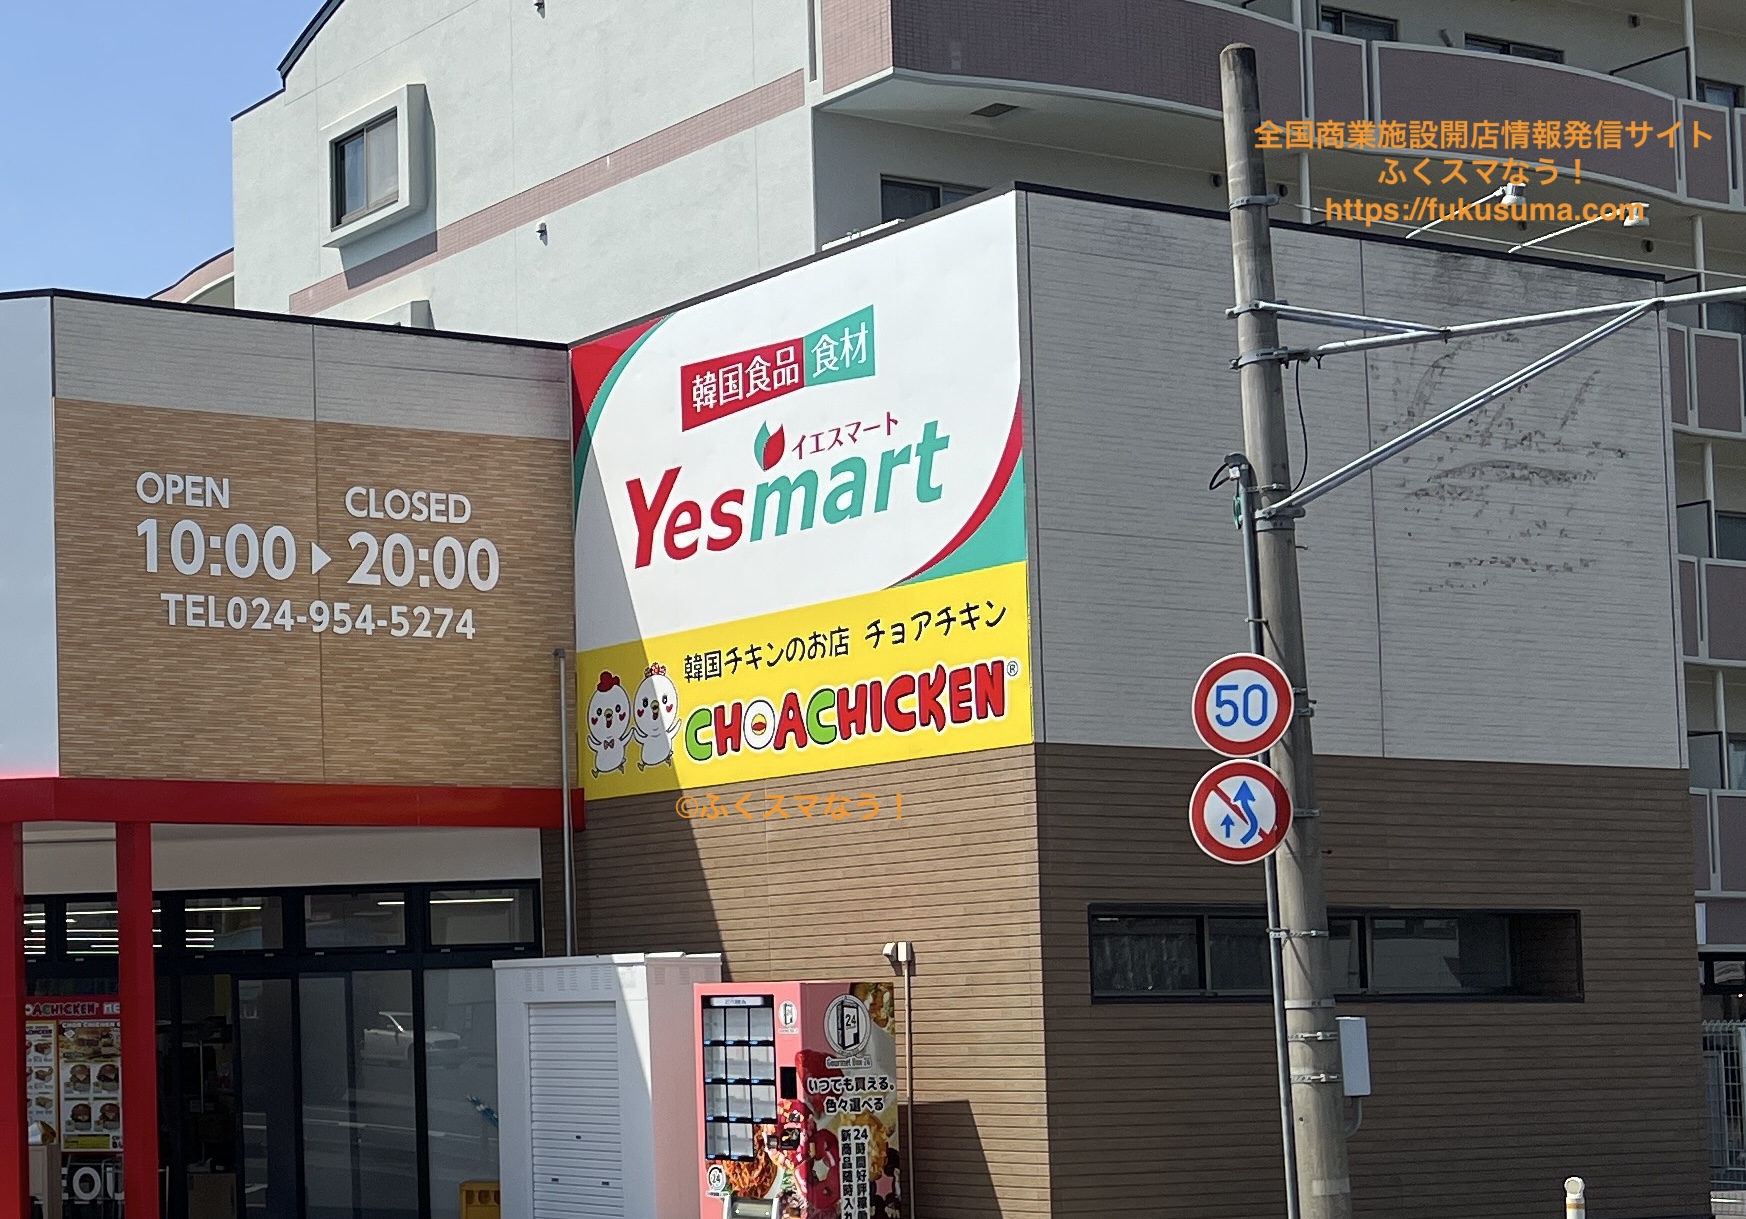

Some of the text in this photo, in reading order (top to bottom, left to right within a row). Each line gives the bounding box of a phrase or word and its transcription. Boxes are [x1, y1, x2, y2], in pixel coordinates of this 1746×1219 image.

[691, 321, 869, 413] 韓国食品 食材
[791, 411, 899, 460] イエスマート
[136, 471, 472, 525] OPEN CLOSED
[625, 420, 951, 570] Yesmart
[136, 518, 500, 592] 10:00 20:00
[160, 592, 477, 641] TEL024-954-5274
[683, 600, 1007, 683] 韓国チキンのお店 チョアチキン
[1215, 683, 1269, 727] 50
[845, 1013, 857, 1027] 24
[808, 1076, 895, 1092] いつでも買える。
[825, 1097, 884, 1113] 色々選べる
